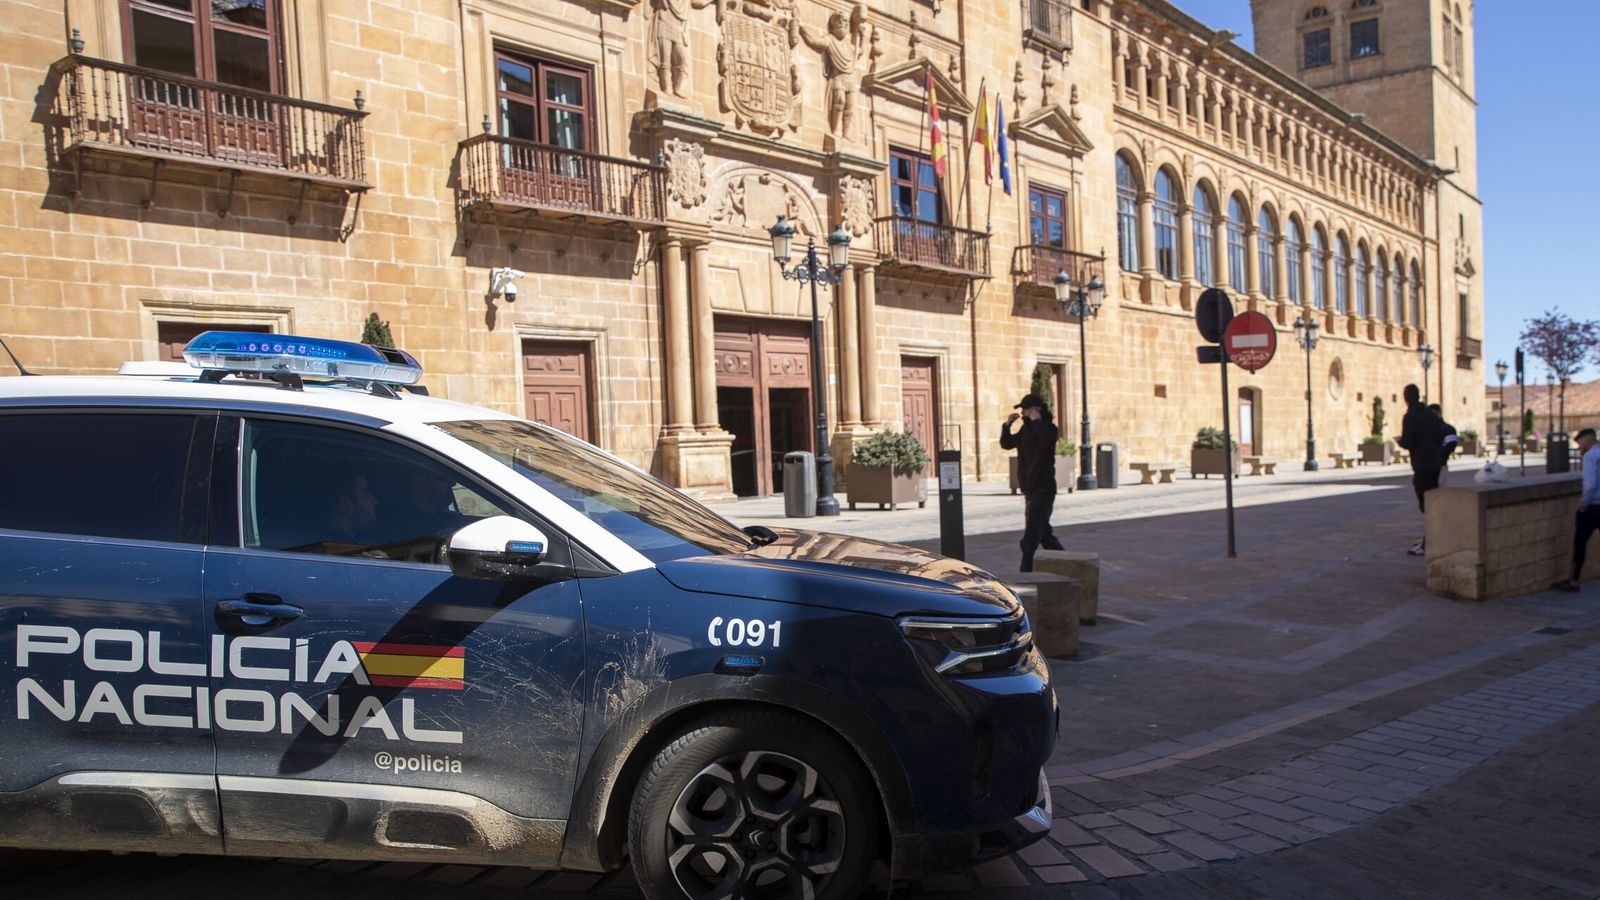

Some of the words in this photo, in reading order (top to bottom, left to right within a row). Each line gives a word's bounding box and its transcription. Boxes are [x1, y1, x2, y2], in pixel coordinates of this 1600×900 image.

[726, 618, 782, 647] 091
[17, 677, 464, 744] NACIONAL
[374, 751, 462, 774] @policia
